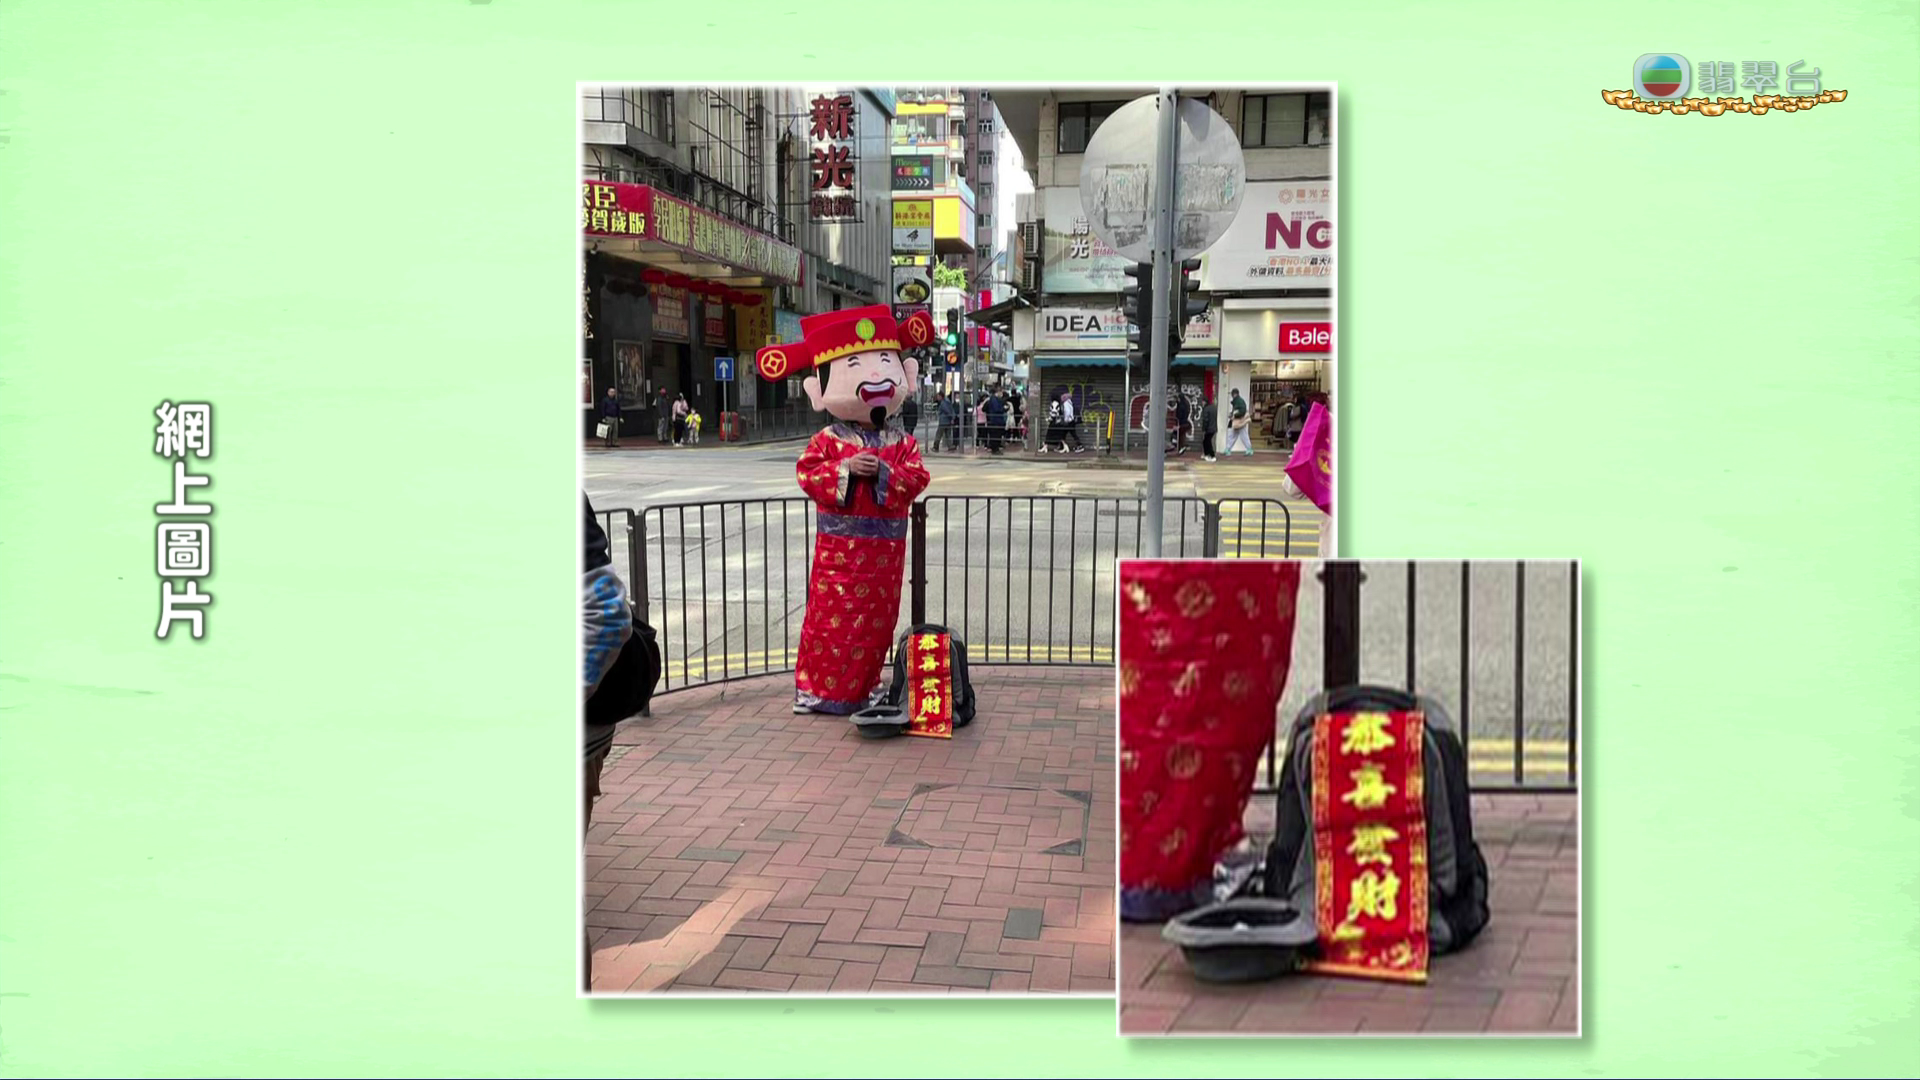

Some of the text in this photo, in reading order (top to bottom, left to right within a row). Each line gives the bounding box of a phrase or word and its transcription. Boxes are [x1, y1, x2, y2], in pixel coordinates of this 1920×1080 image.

[810, 93, 854, 190] 新光
[1071, 216, 1090, 259] 陽光
[1045, 315, 1102, 332] IDEA
[1289, 326, 1333, 346] Bale
